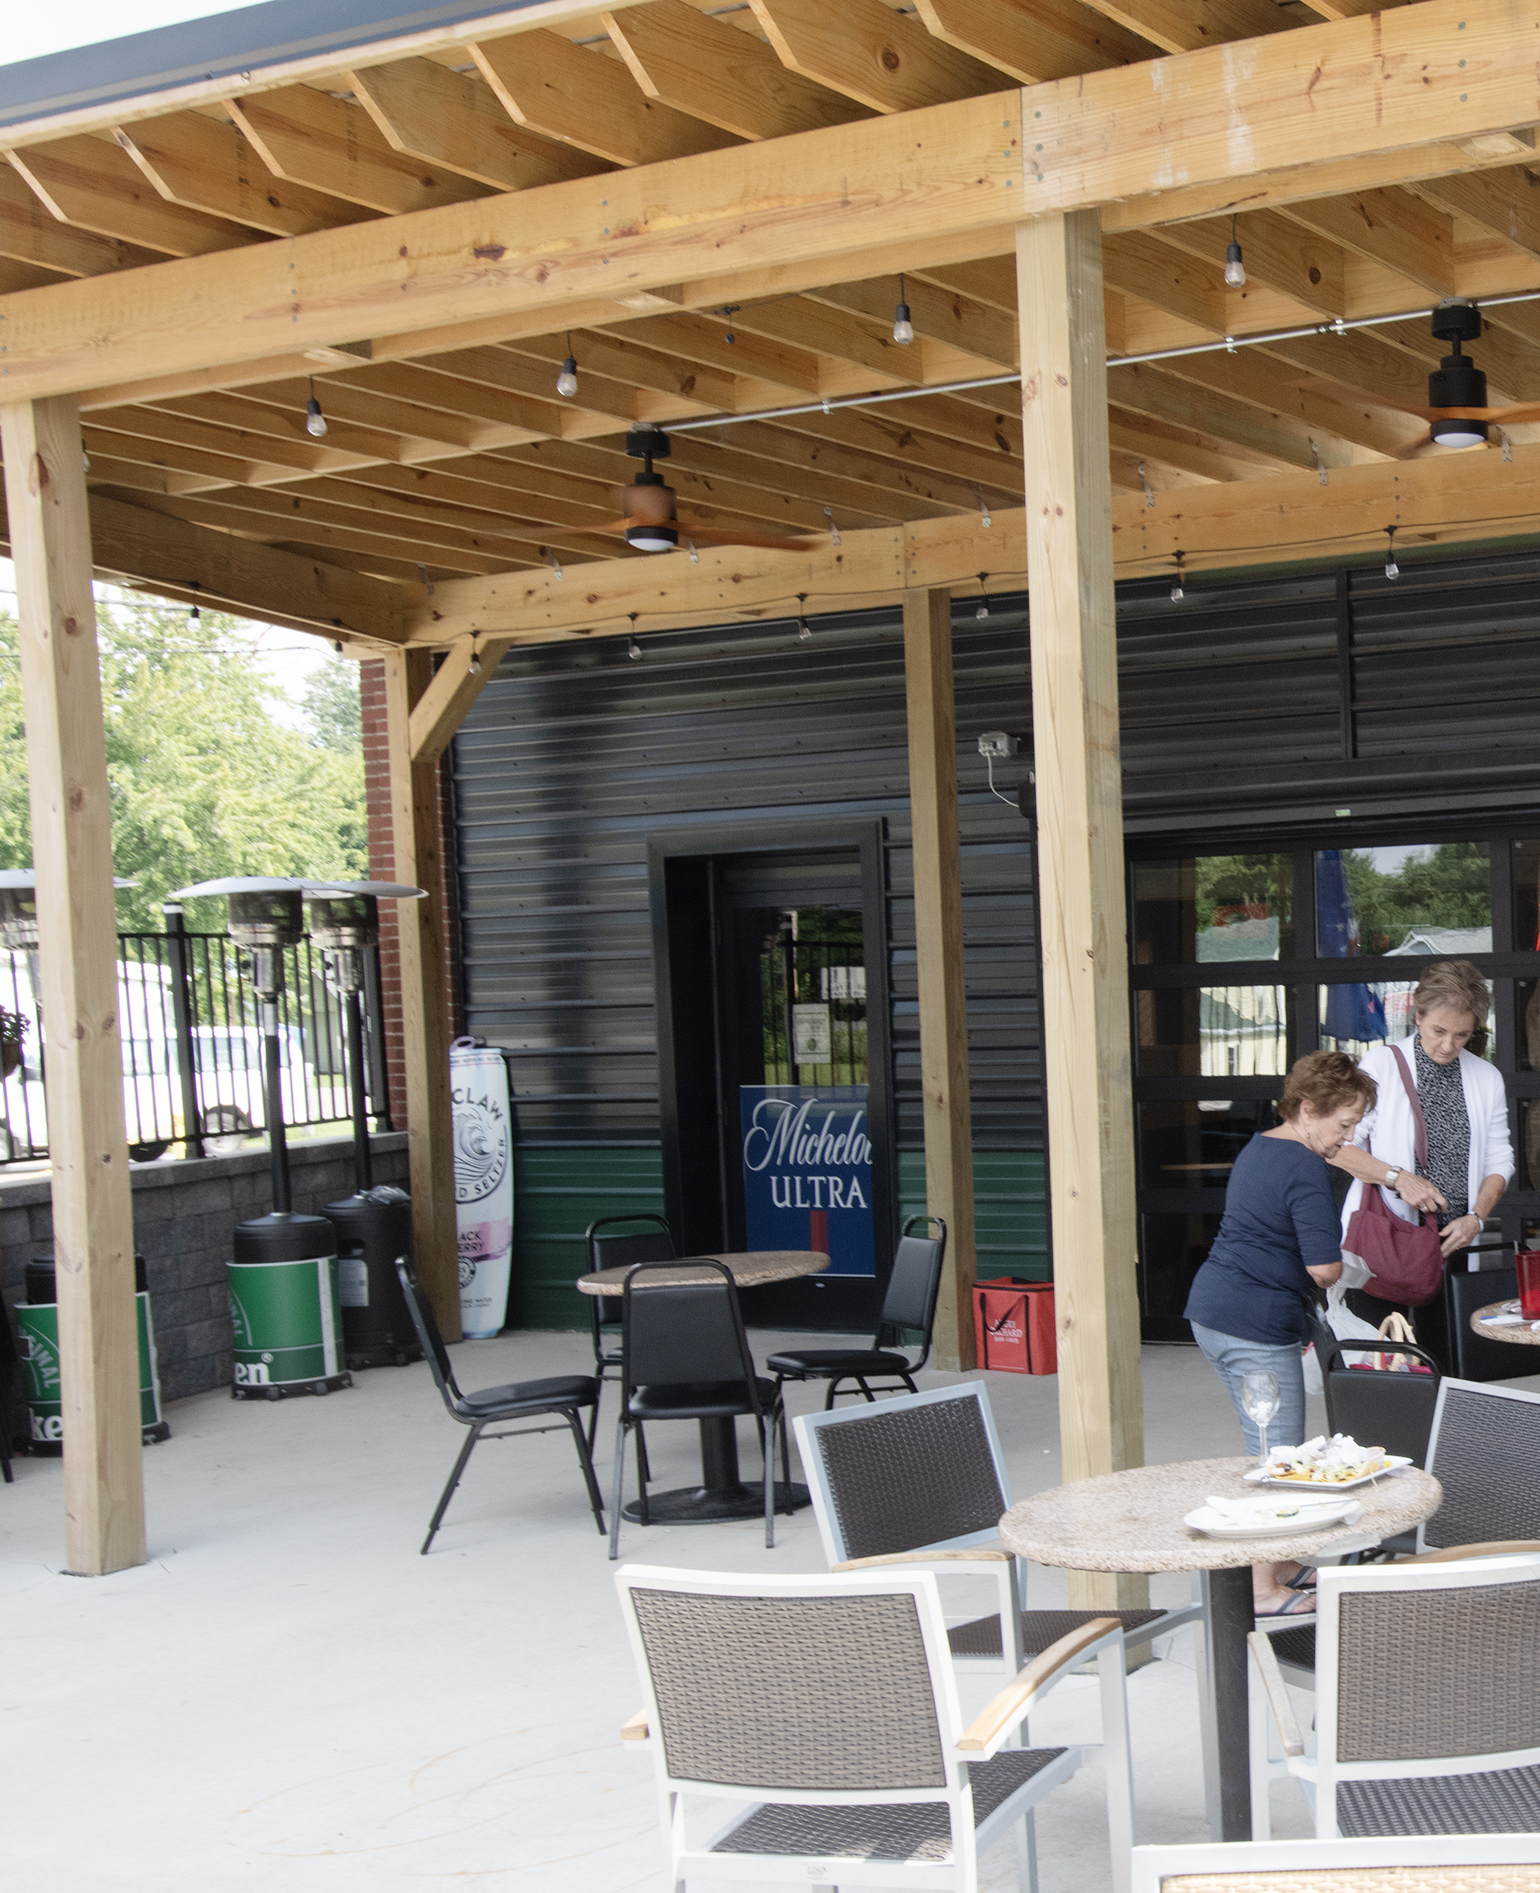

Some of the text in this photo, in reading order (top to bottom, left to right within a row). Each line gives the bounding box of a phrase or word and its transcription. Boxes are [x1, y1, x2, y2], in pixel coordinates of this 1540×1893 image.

[451, 1087, 503, 1122] CLAW
[474, 1138, 506, 1196] SELTZER
[769, 1175, 869, 1209] ULTRA
